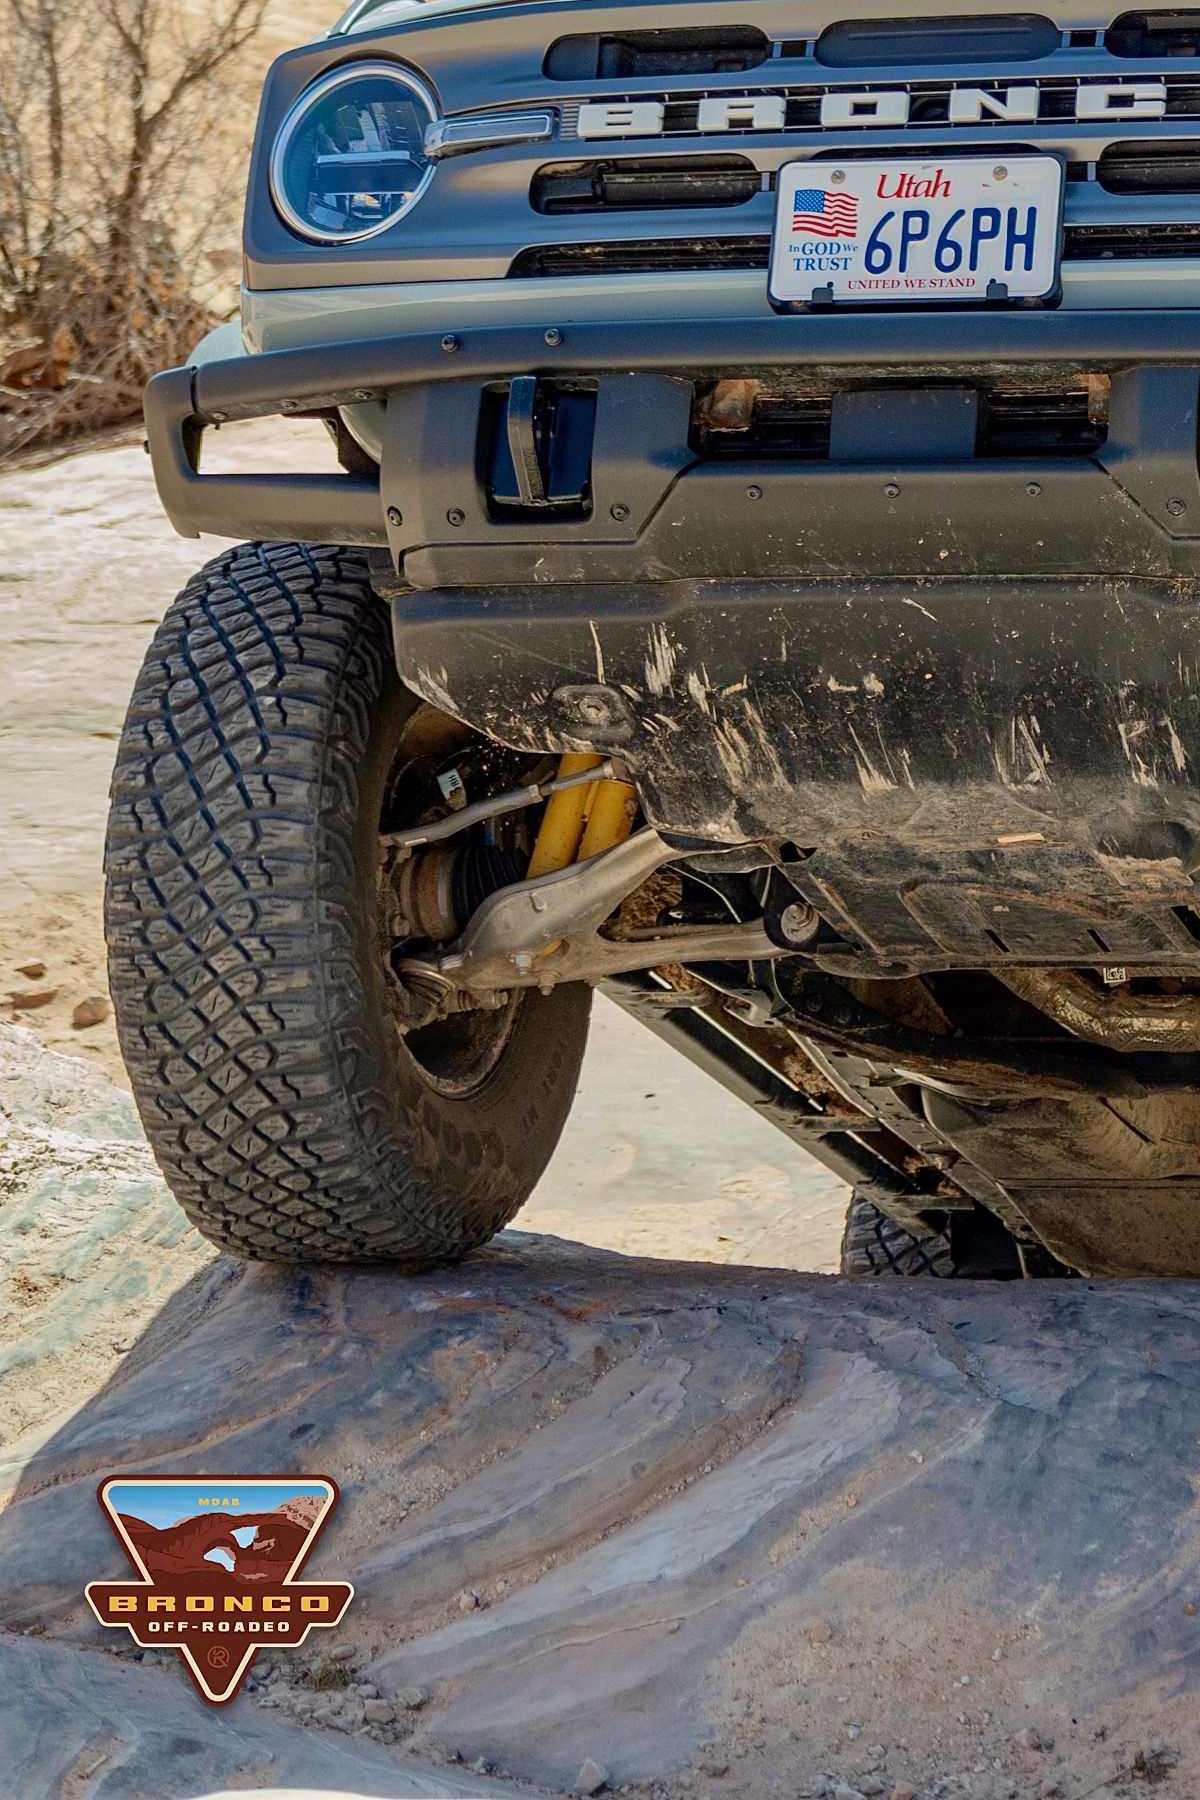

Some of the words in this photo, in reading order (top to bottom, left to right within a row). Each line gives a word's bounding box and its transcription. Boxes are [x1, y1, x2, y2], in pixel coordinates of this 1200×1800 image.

[876, 169, 952, 199] Utah
[864, 206, 1037, 275] 6P6PH
[789, 244, 800, 253] In
[802, 242, 841, 256] GOD
[843, 243, 858, 253] We
[793, 257, 852, 272] TRUST
[848, 279, 900, 290] UNITED
[904, 279, 926, 289] WE
[929, 277, 976, 289] STAND
